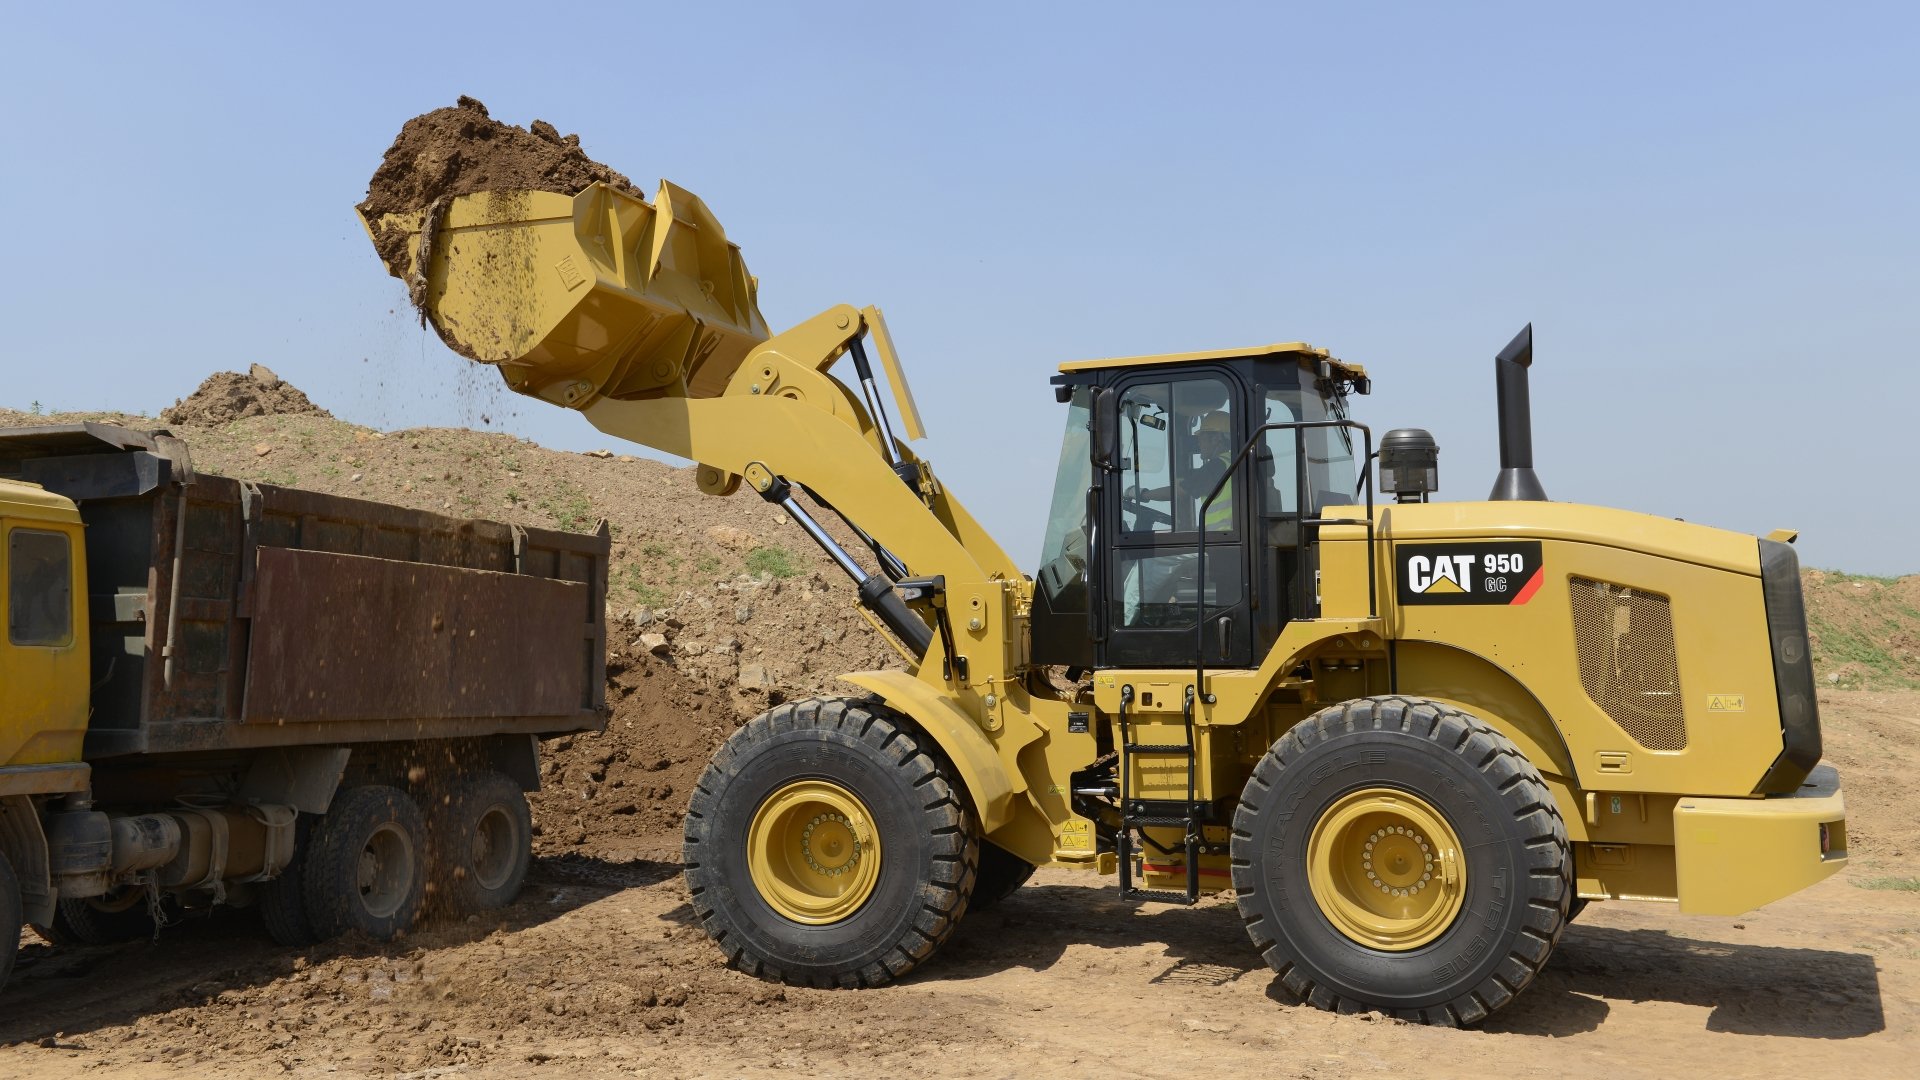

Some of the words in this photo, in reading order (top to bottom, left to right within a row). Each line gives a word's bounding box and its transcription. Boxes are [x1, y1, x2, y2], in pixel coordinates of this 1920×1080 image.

[1408, 555, 1475, 593] CAT
[1484, 553, 1523, 573] 950
[1485, 577, 1507, 592] GC
[1271, 750, 1386, 911] TRIANGLE
